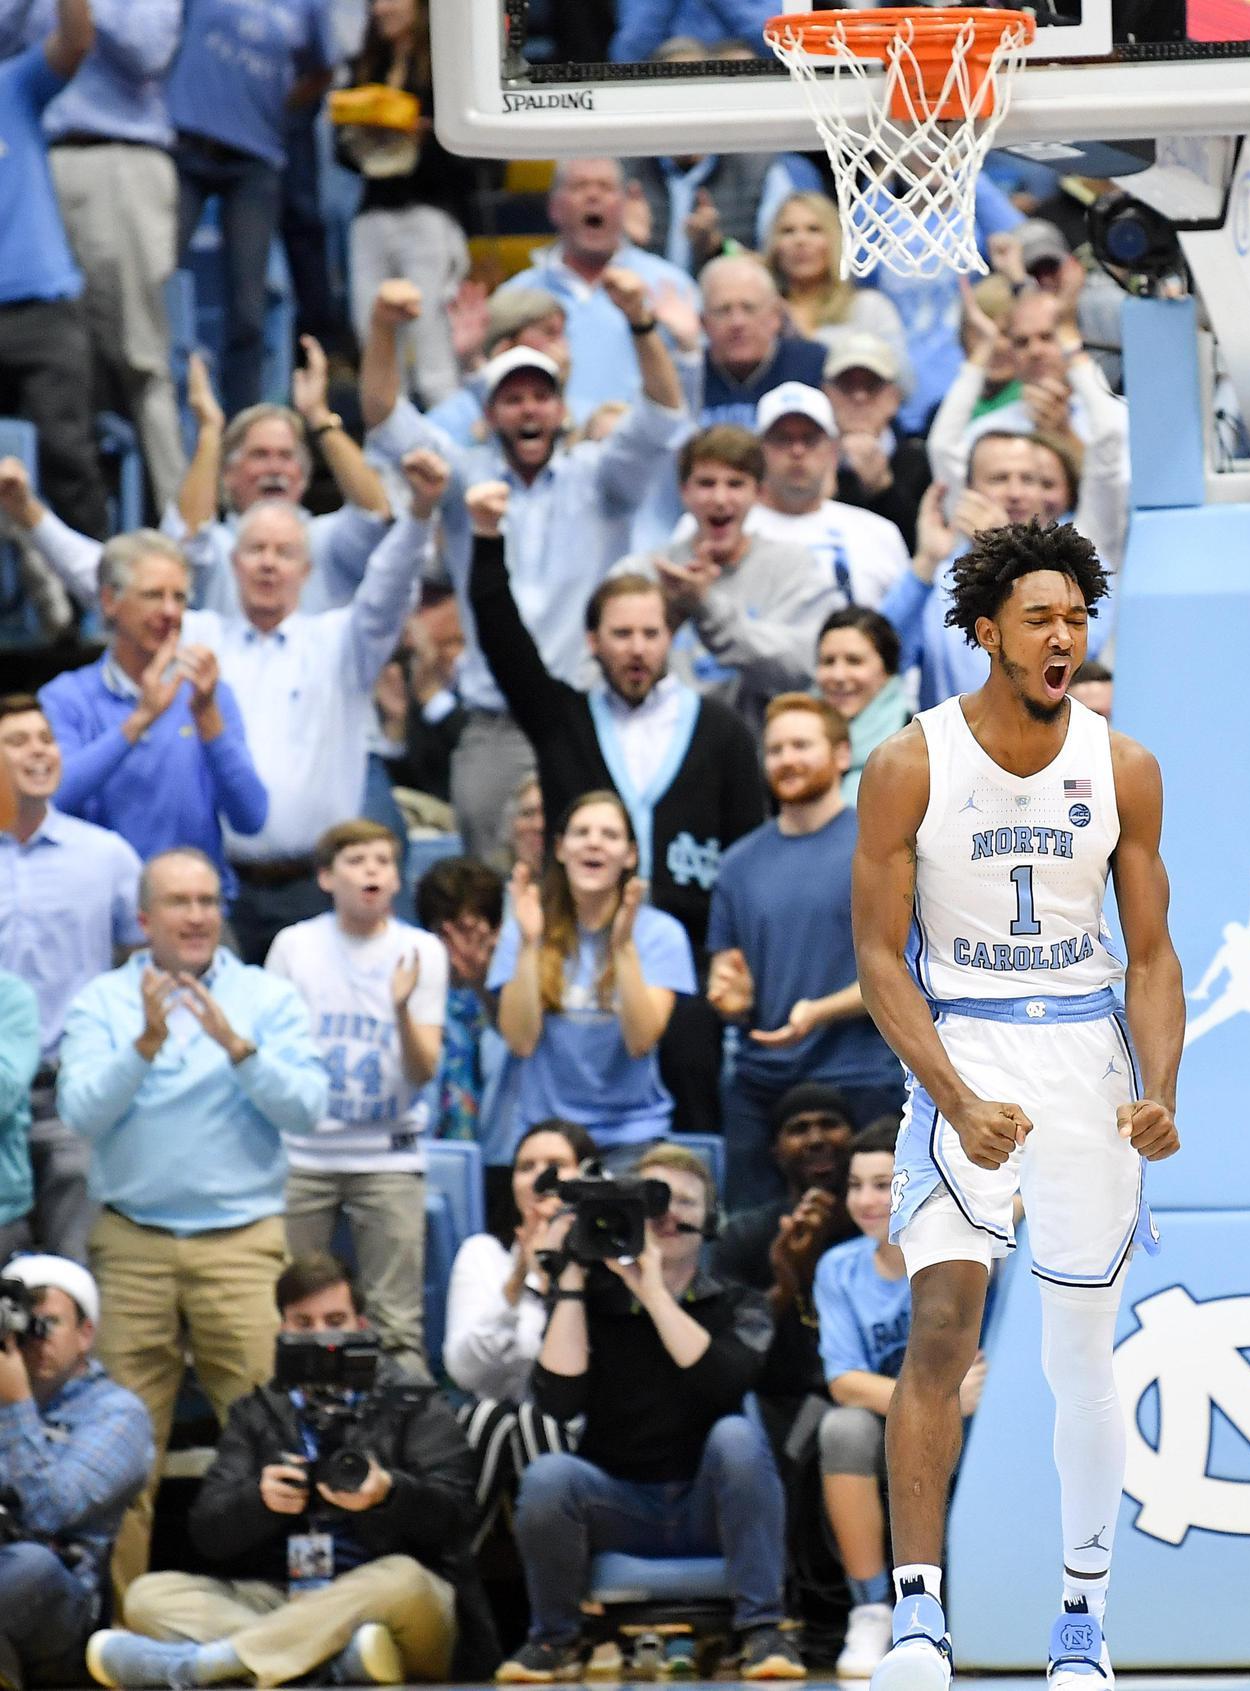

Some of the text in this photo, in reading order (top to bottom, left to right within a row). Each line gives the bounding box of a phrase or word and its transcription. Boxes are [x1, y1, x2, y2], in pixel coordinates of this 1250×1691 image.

[502, 90, 593, 113] SPALDING
[971, 826, 1073, 860] NORTH
[1010, 865, 1041, 935] 1
[954, 933, 1093, 971] CAROLINA
